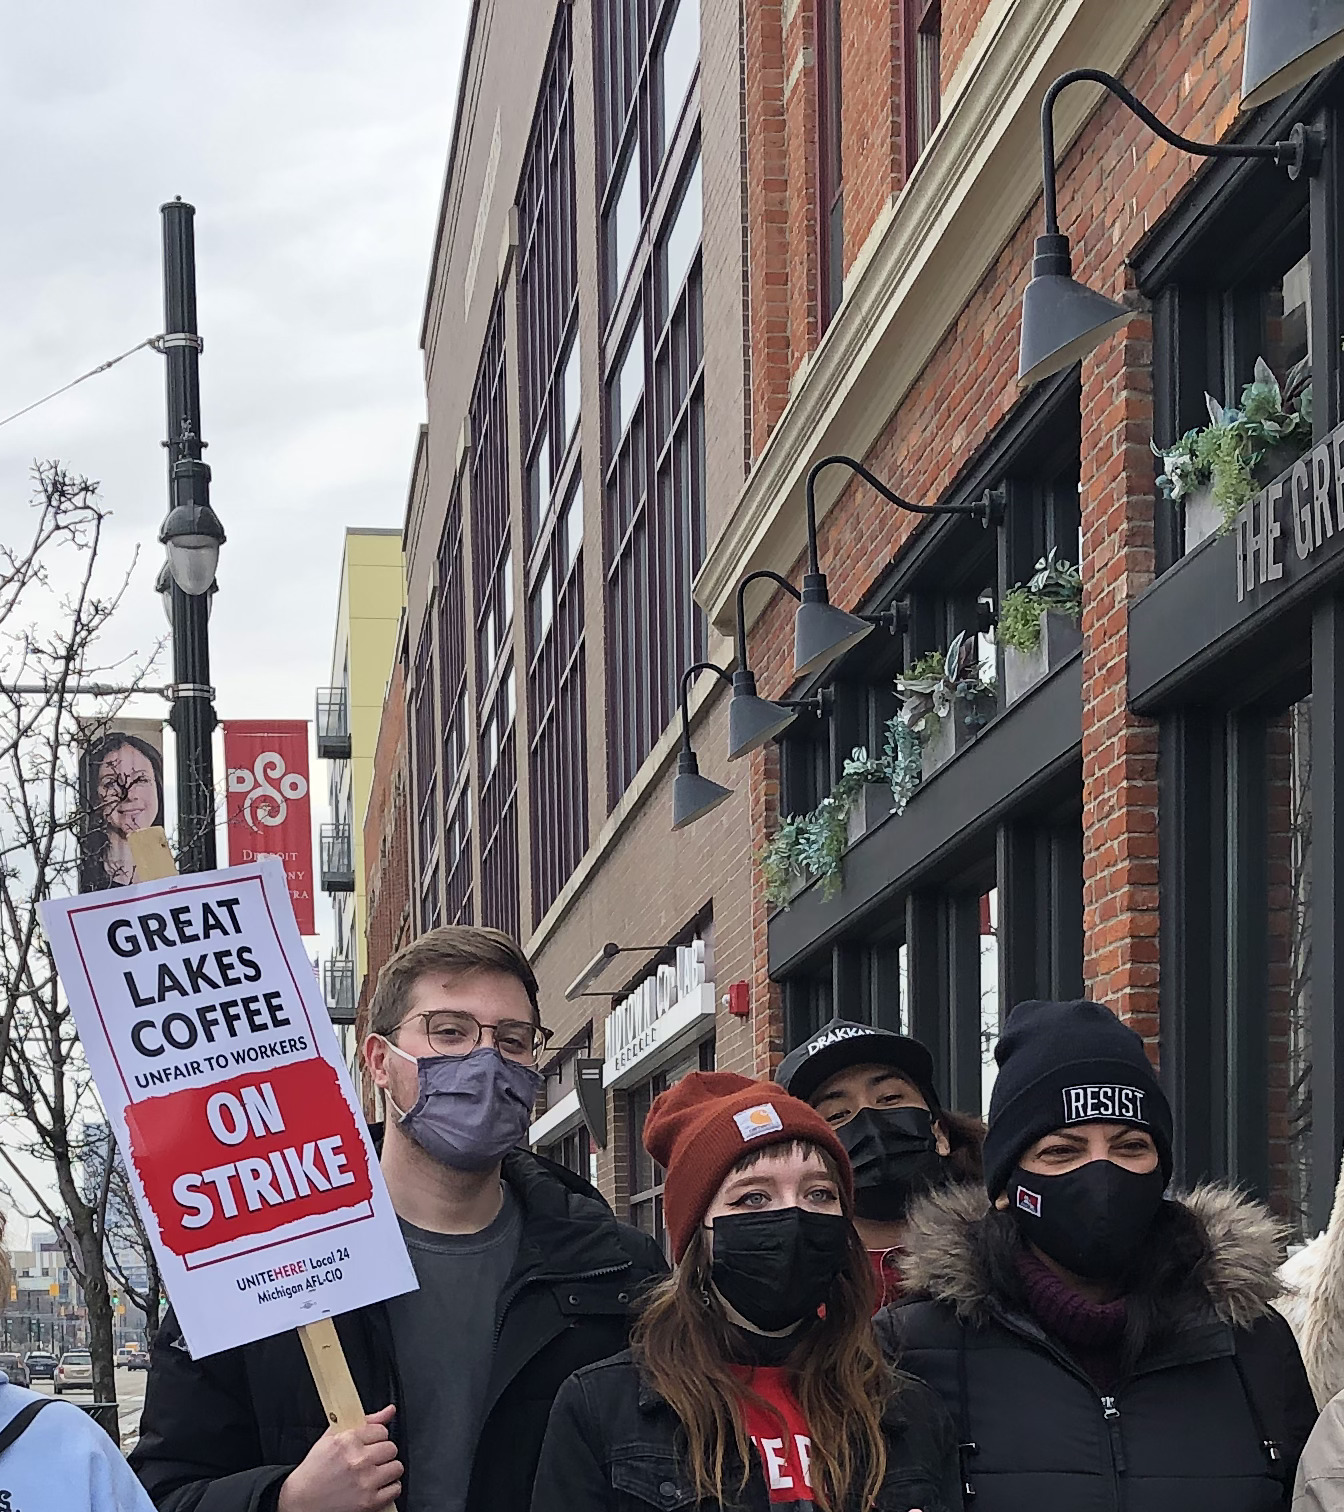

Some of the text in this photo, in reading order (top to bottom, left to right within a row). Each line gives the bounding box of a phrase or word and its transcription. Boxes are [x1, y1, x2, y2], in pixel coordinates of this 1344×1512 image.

[1236, 484, 1283, 602] THE
[107, 898, 242, 957] GREAT
[123, 946, 261, 1008] LAKES
[131, 991, 291, 1057] COFFEE
[135, 1036, 307, 1088] UNFAIR TO WORKERS
[207, 1083, 285, 1144] ON
[1070, 1088, 1144, 1120] RESIST
[173, 1135, 354, 1227] STRIKE
[236, 1248, 350, 1293] UNITEHERE! Local 24
[258, 1268, 342, 1304] Michigan AFL-CIO
